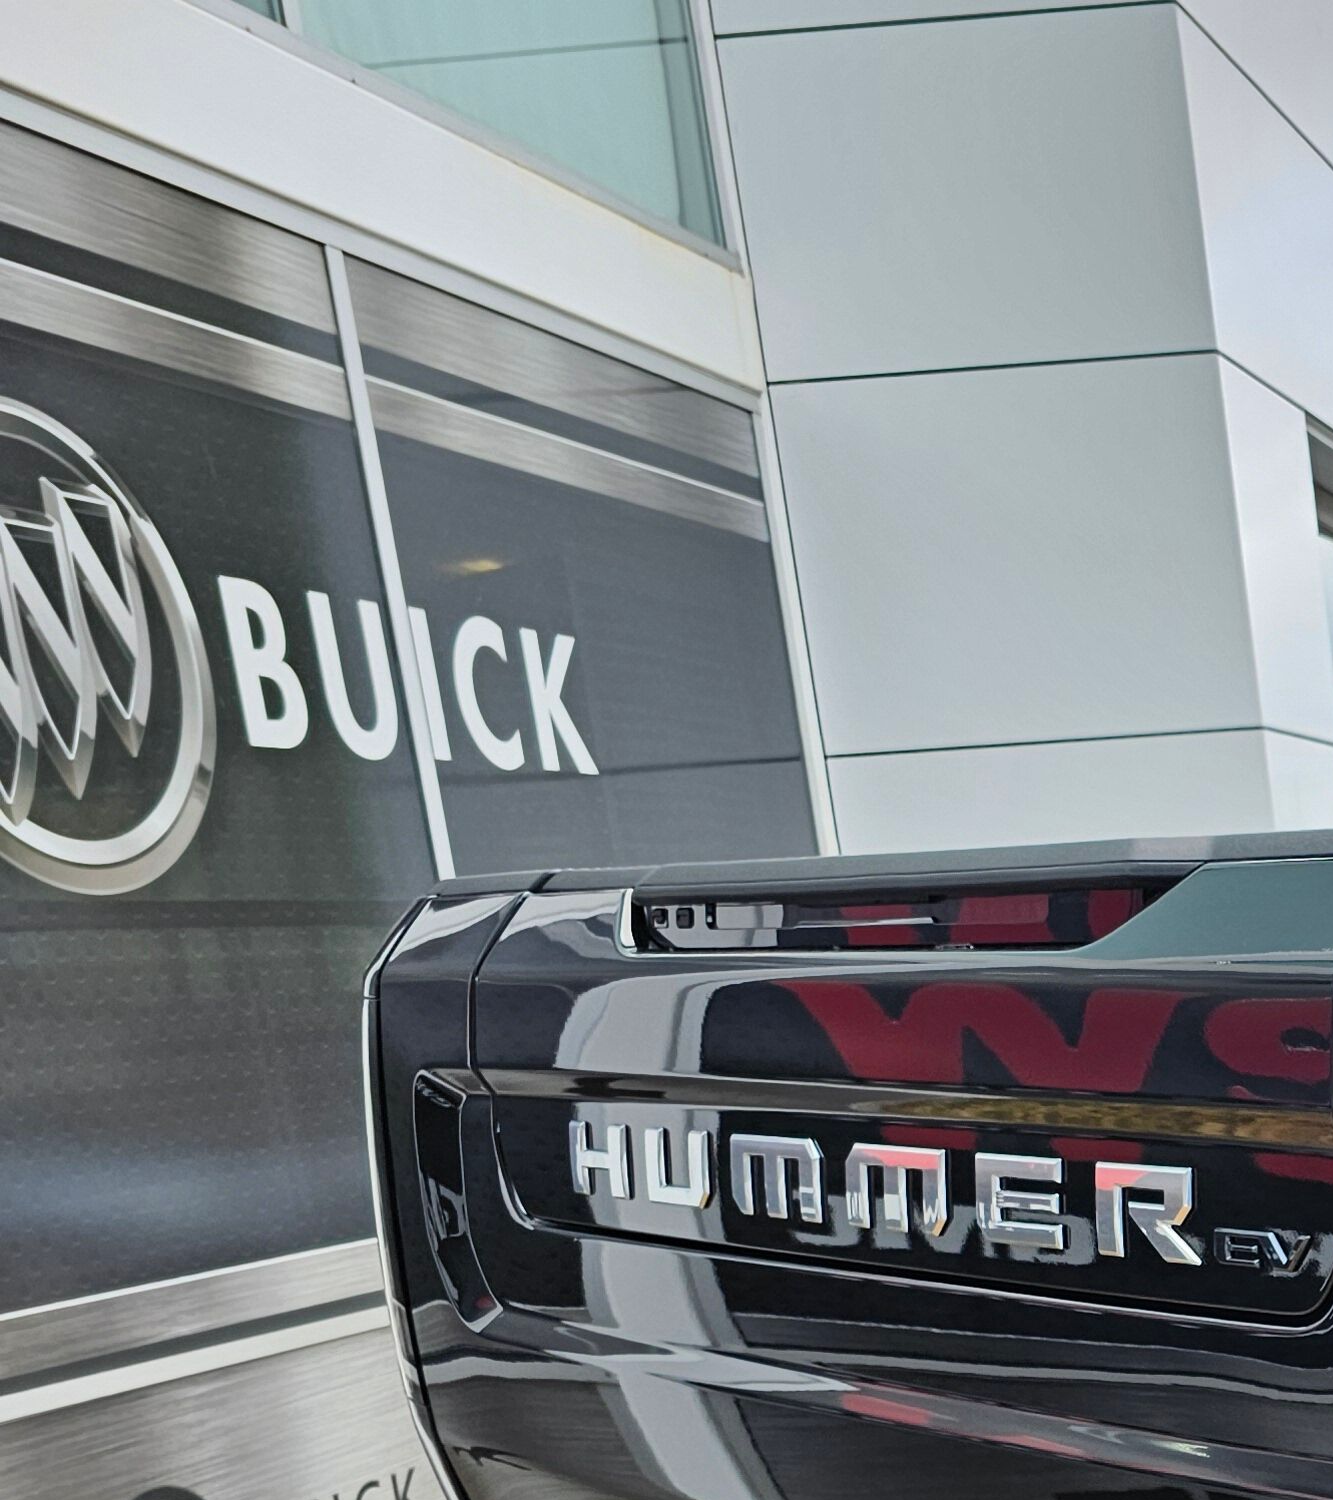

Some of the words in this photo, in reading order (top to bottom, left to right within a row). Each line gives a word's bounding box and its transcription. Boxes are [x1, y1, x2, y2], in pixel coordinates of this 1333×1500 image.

[217, 574, 600, 776] BUICK
[568, 1119, 1202, 1266] HUMMER
[1213, 1226, 1311, 1273] EV
